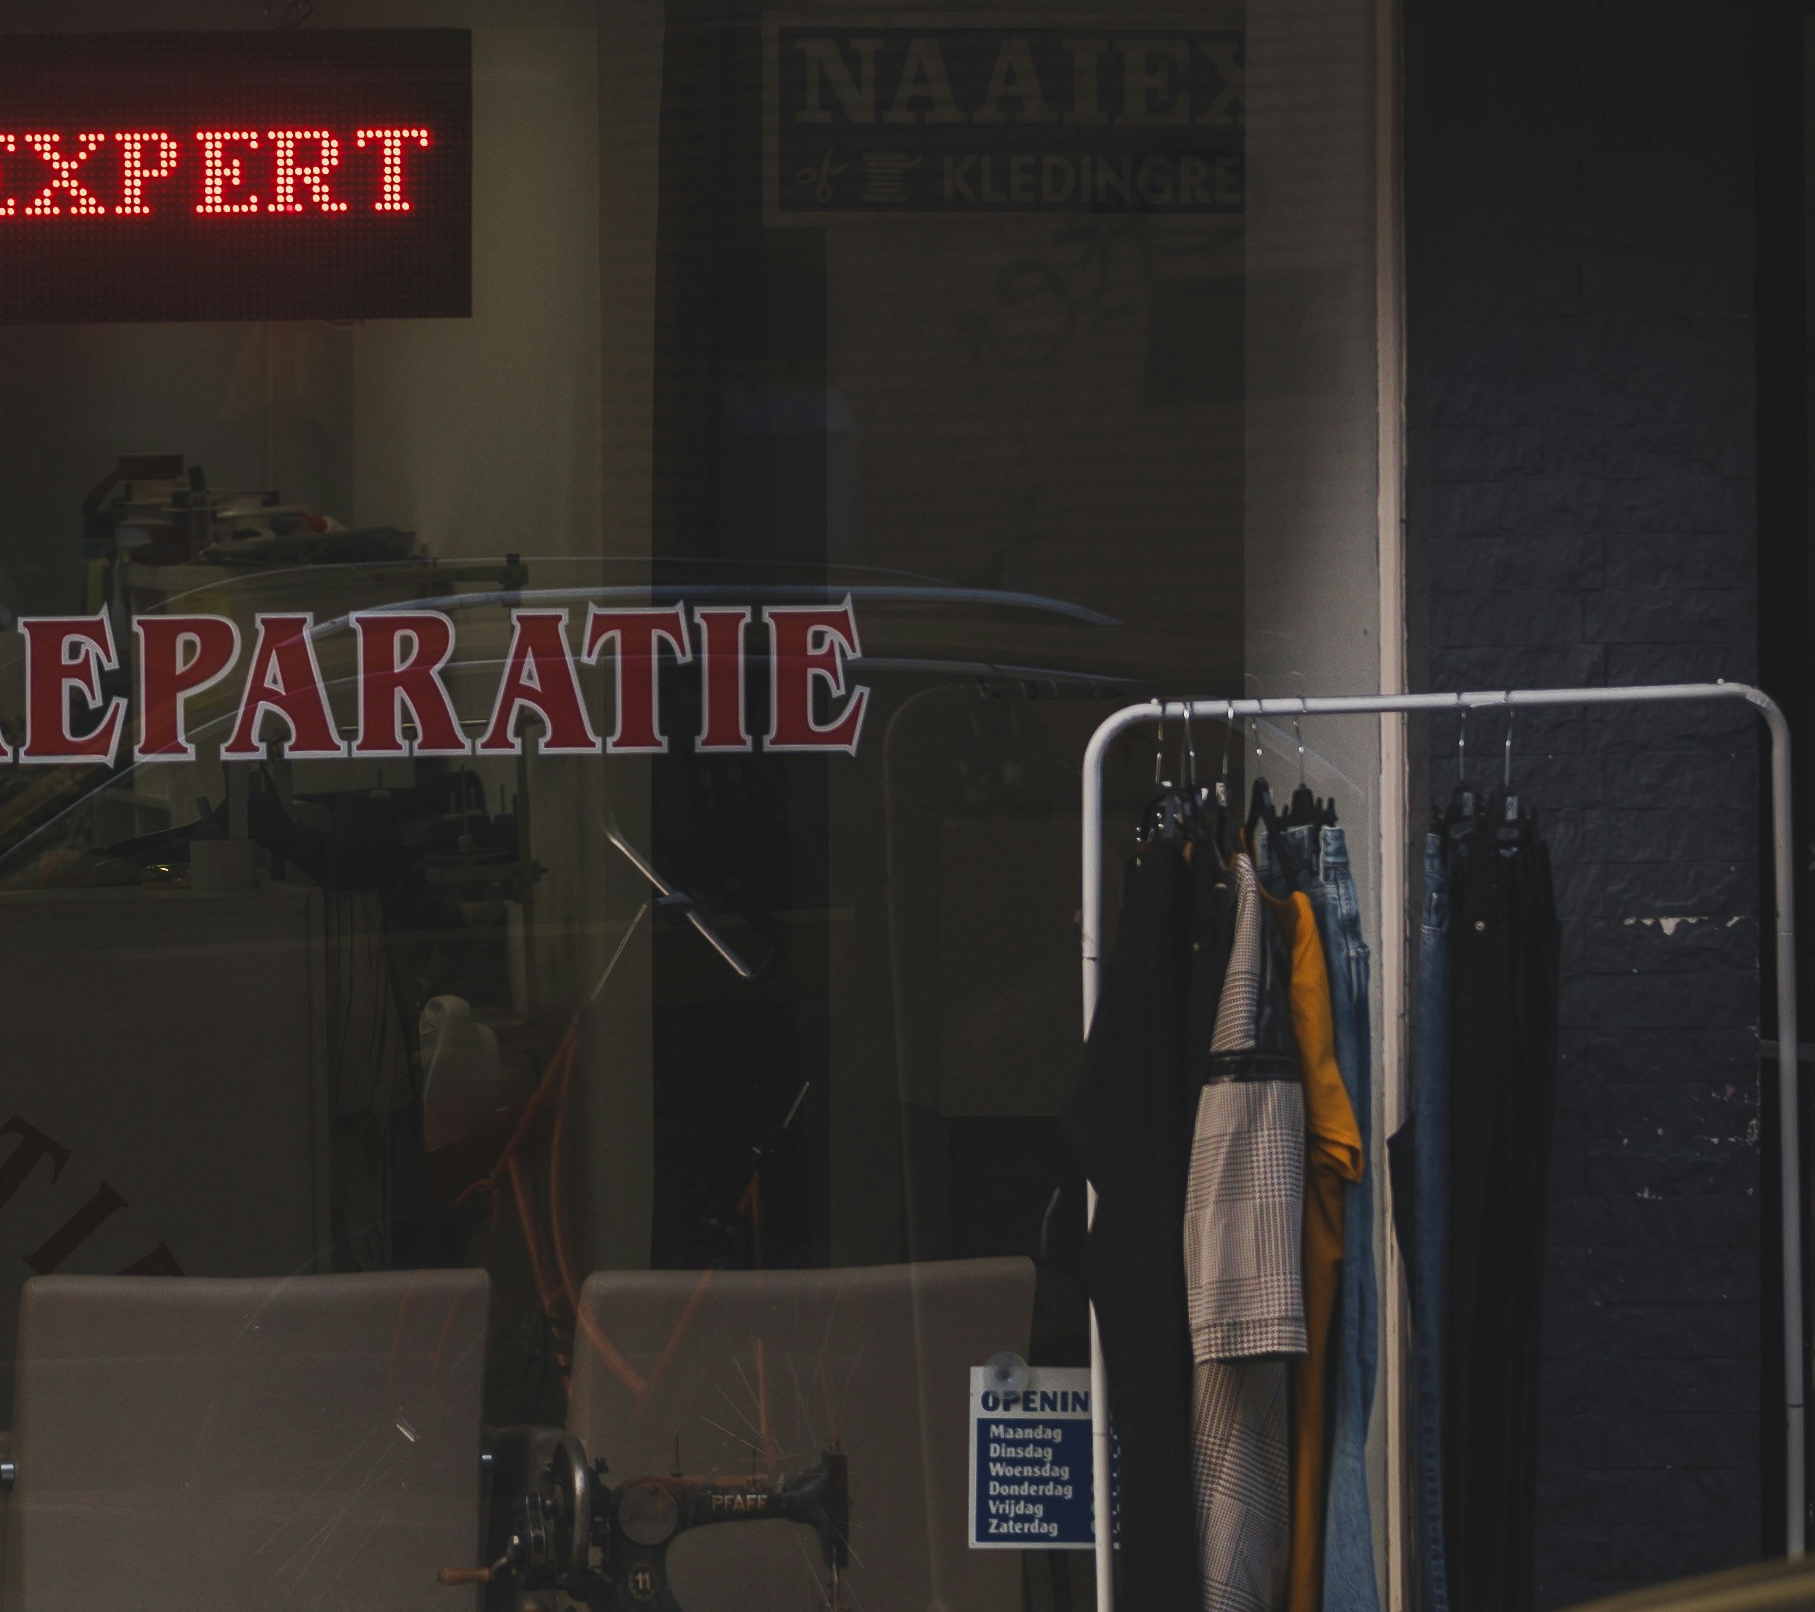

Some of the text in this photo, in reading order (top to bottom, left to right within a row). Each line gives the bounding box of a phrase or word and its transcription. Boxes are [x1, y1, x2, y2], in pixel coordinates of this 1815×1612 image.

[989, 1424, 1062, 1442] Maandag
[989, 1443, 1053, 1460] Dinsdag
[988, 1461, 1070, 1480] Woensdag
[988, 1481, 1073, 1499] Donderdag
[712, 1495, 768, 1512] PFAFF
[988, 1500, 1044, 1518] Vrijdag
[988, 1519, 1058, 1537] Zaterdag
[634, 1572, 651, 1589] 11
